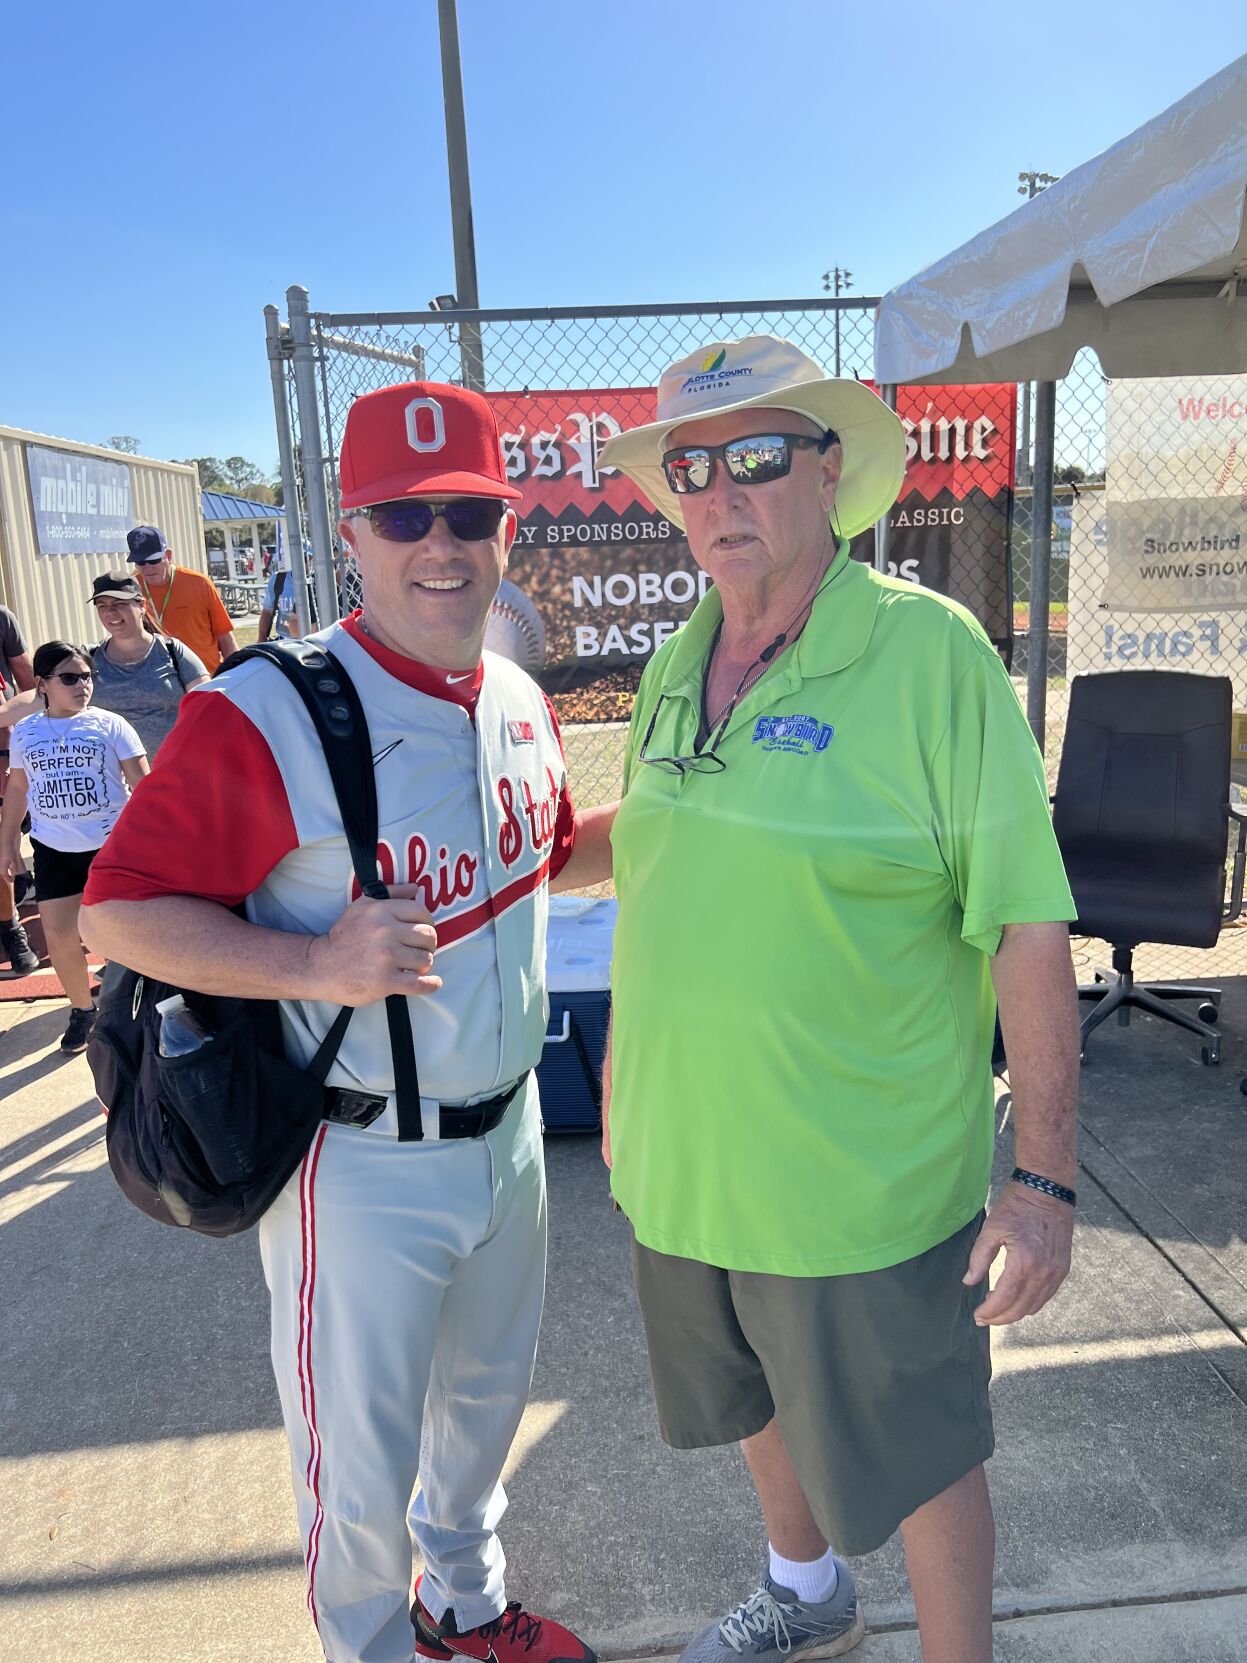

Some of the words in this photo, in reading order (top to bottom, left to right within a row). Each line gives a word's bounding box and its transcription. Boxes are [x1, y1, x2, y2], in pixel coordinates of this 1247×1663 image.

[718, 367, 753, 378] COUNTY
[688, 381, 730, 393] FLORIDA
[1177, 396, 1247, 421] Welc
[404, 397, 446, 453] O
[40, 463, 98, 514] mobile
[100, 478, 128, 517] mini
[547, 521, 671, 543] SPONSORS
[1143, 535, 1240, 554] Snowbird
[25, 748, 49, 762] YES,
[52, 745, 69, 754] I'M
[72, 744, 98, 757] NOT
[31, 756, 94, 772] PERFECT
[46, 771, 62, 779] but
[37, 777, 95, 794] LIMITED
[38, 791, 98, 809] EDITION
